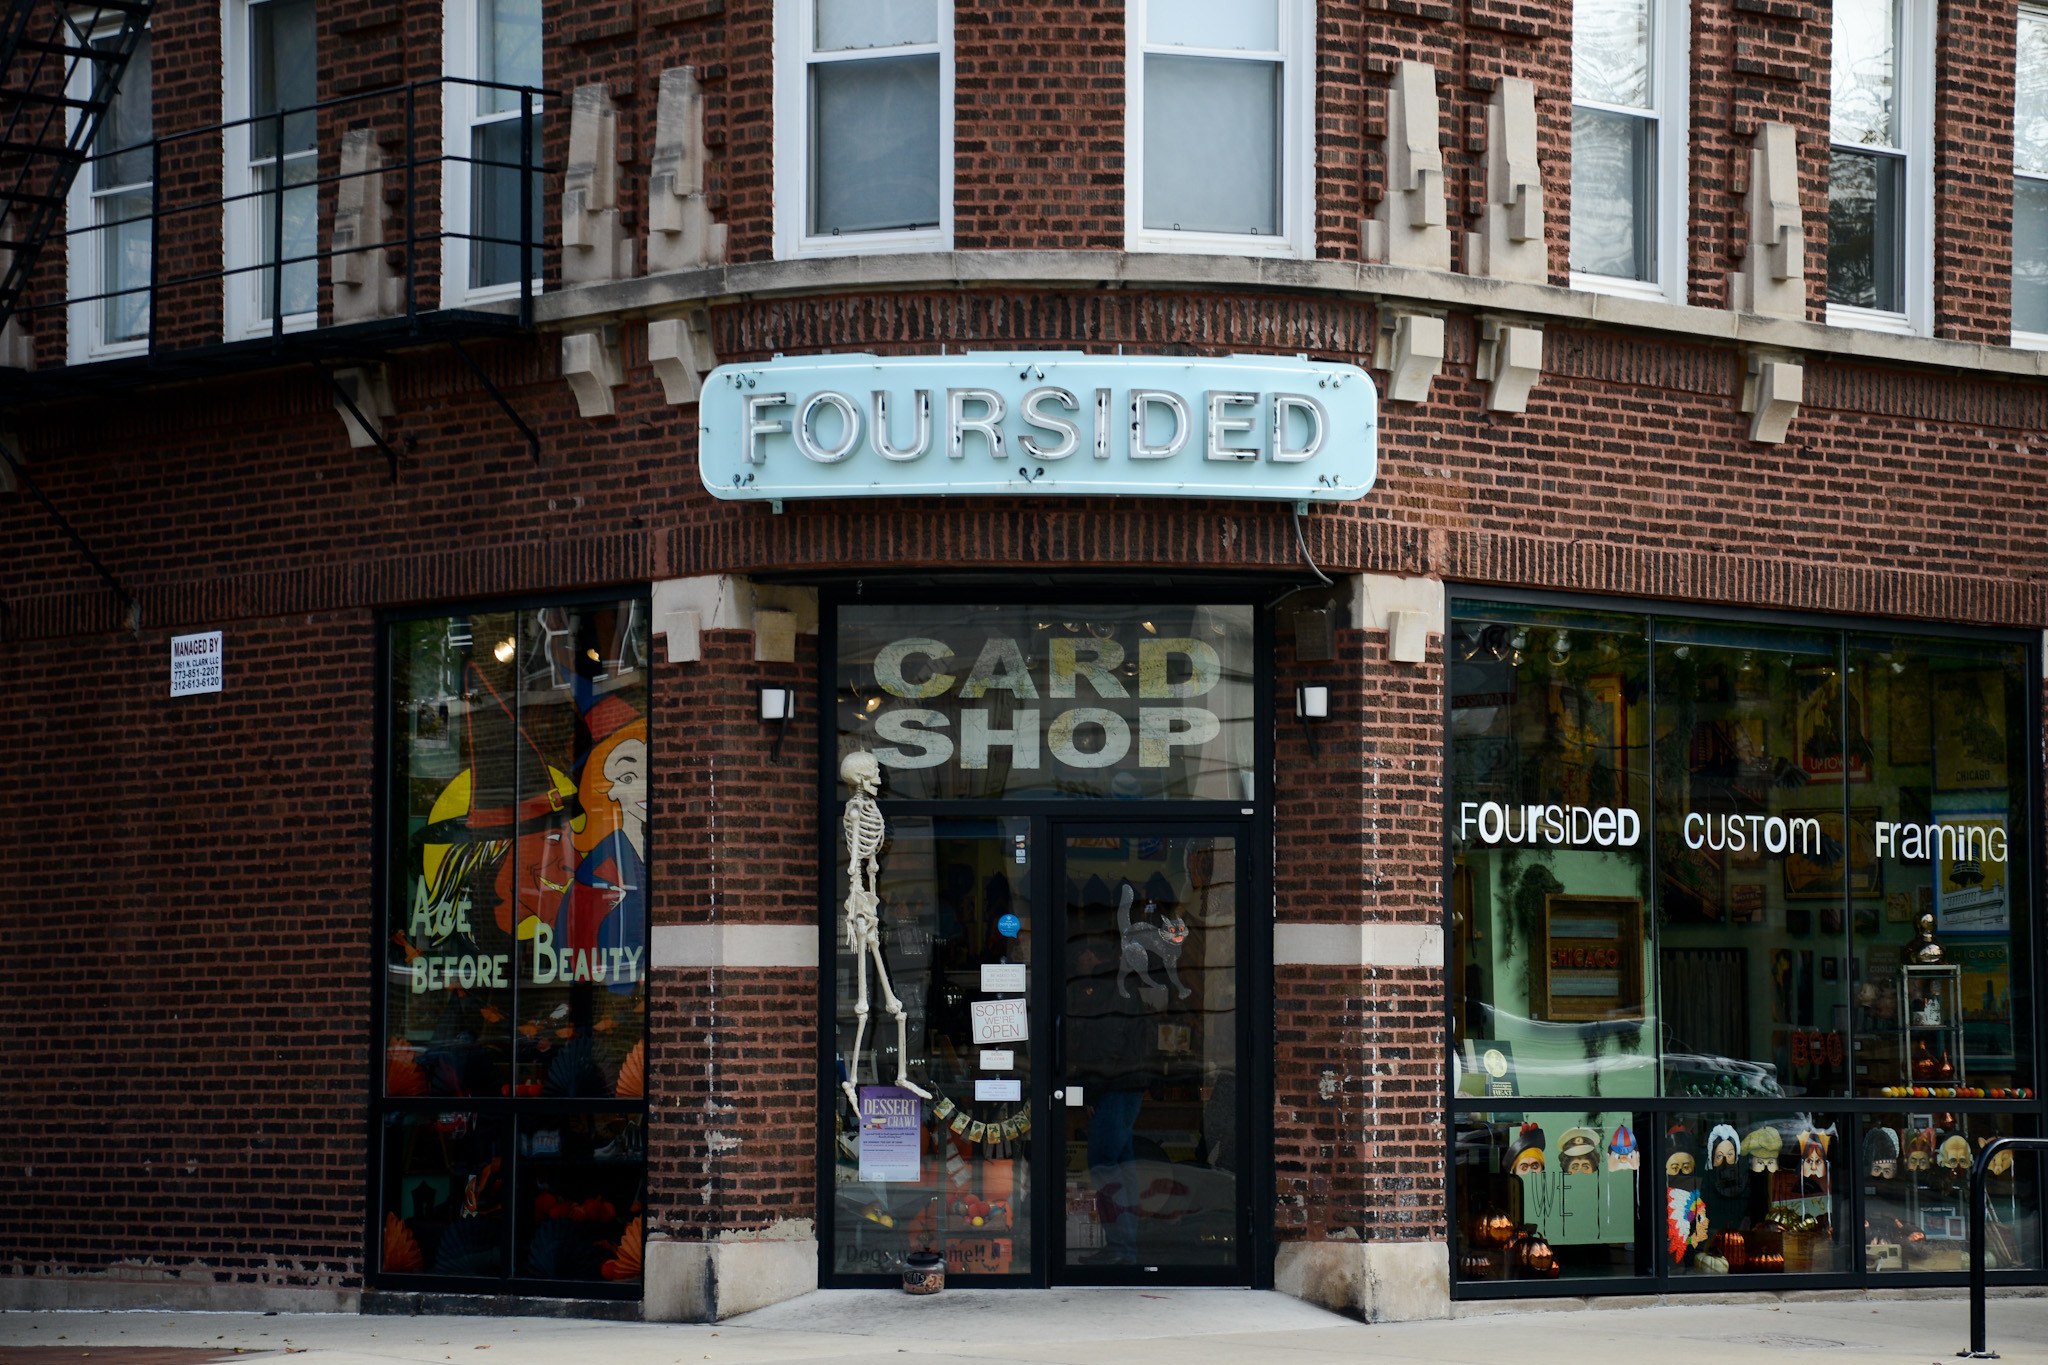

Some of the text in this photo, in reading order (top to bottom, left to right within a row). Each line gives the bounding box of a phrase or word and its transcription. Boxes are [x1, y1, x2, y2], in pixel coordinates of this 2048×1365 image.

[742, 386, 1331, 465] FOURSIDED
[174, 637, 219, 657] MANAGED BY
[174, 661, 185, 670] 5061
[192, 658, 209, 667] CLARK
[209, 656, 219, 665] LLC
[873, 637, 1221, 699] CARD
[174, 666, 219, 680] 773-851-2207
[173, 676, 219, 691] 312-613-6120
[872, 707, 1221, 770] SHOP
[1956, 769, 1990, 782] CHICAGO
[409, 875, 472, 937] AGE
[533, 922, 643, 984] BEAUTY
[1550, 948, 1619, 968] CHICAGO
[1951, 948, 2006, 961] HICAGO
[412, 954, 509, 994] BEFORE
[976, 1002, 1023, 1017] SORRY,
[985, 1015, 1015, 1025] WE'RE
[982, 1024, 1020, 1039] OPEN
[864, 1098, 918, 1116] DESSERT
[887, 1115, 918, 1128] CRAWL
[846, 1244, 891, 1269] Dogs
